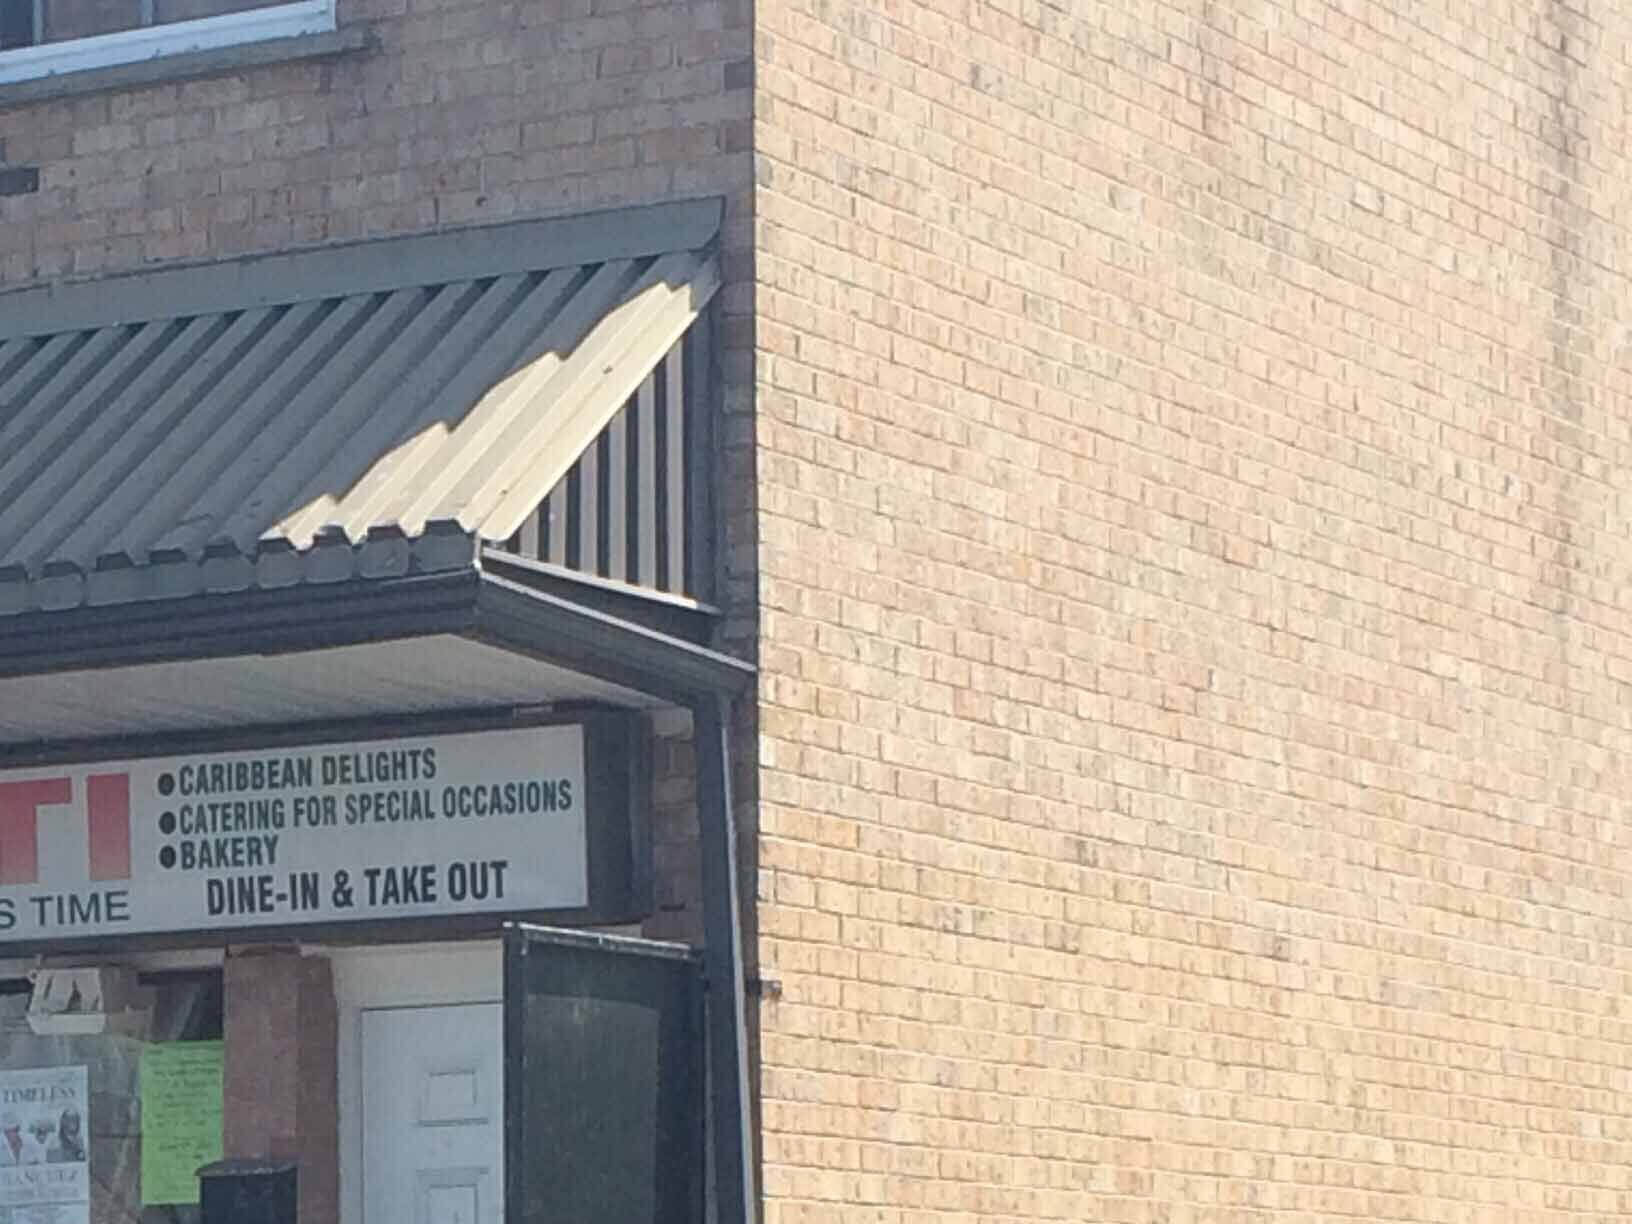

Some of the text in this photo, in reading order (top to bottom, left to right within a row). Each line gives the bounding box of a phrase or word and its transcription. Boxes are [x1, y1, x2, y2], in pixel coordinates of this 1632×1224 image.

[179, 748, 436, 797] CARIBBEAN DELIGHTS
[179, 779, 572, 835] CATERING FOR SPECIAL OCCASIONS
[180, 835, 279, 871] BAKERY
[28, 889, 131, 927] TIME
[207, 860, 509, 917] DINE-IN & TAKE OUT
